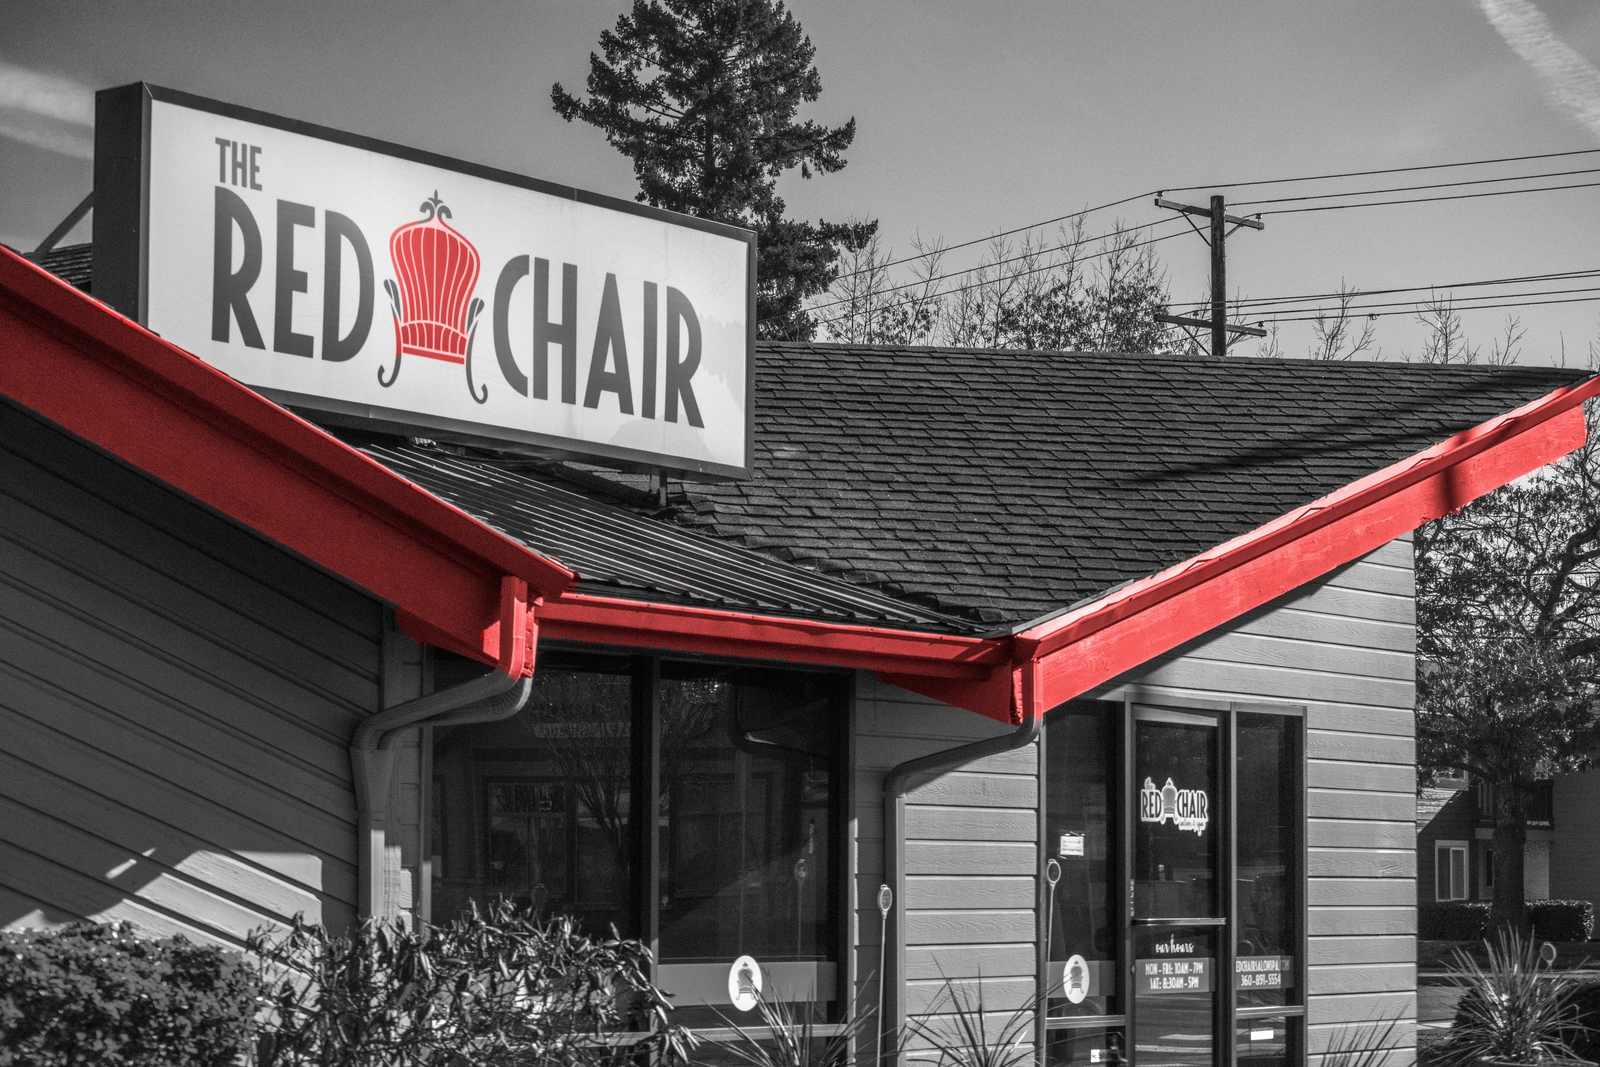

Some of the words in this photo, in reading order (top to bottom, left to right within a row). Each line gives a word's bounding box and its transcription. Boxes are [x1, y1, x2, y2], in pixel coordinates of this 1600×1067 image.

[215, 137, 262, 192] THE
[211, 185, 375, 363] RED
[493, 254, 705, 429] CHAIR
[1142, 790, 1162, 818] RED
[1177, 791, 1207, 819] CHAIR
[1170, 934, 1194, 953] hours
[1145, 963, 1158, 975] MON
[1162, 962, 1174, 975] FRI:
[1174, 962, 1189, 974] 10AM
[1193, 962, 1203, 974] 7PM
[1150, 977, 1162, 989] SAT:
[1162, 976, 1184, 989] 8:30AM
[1188, 976, 1199, 988] 5PM
